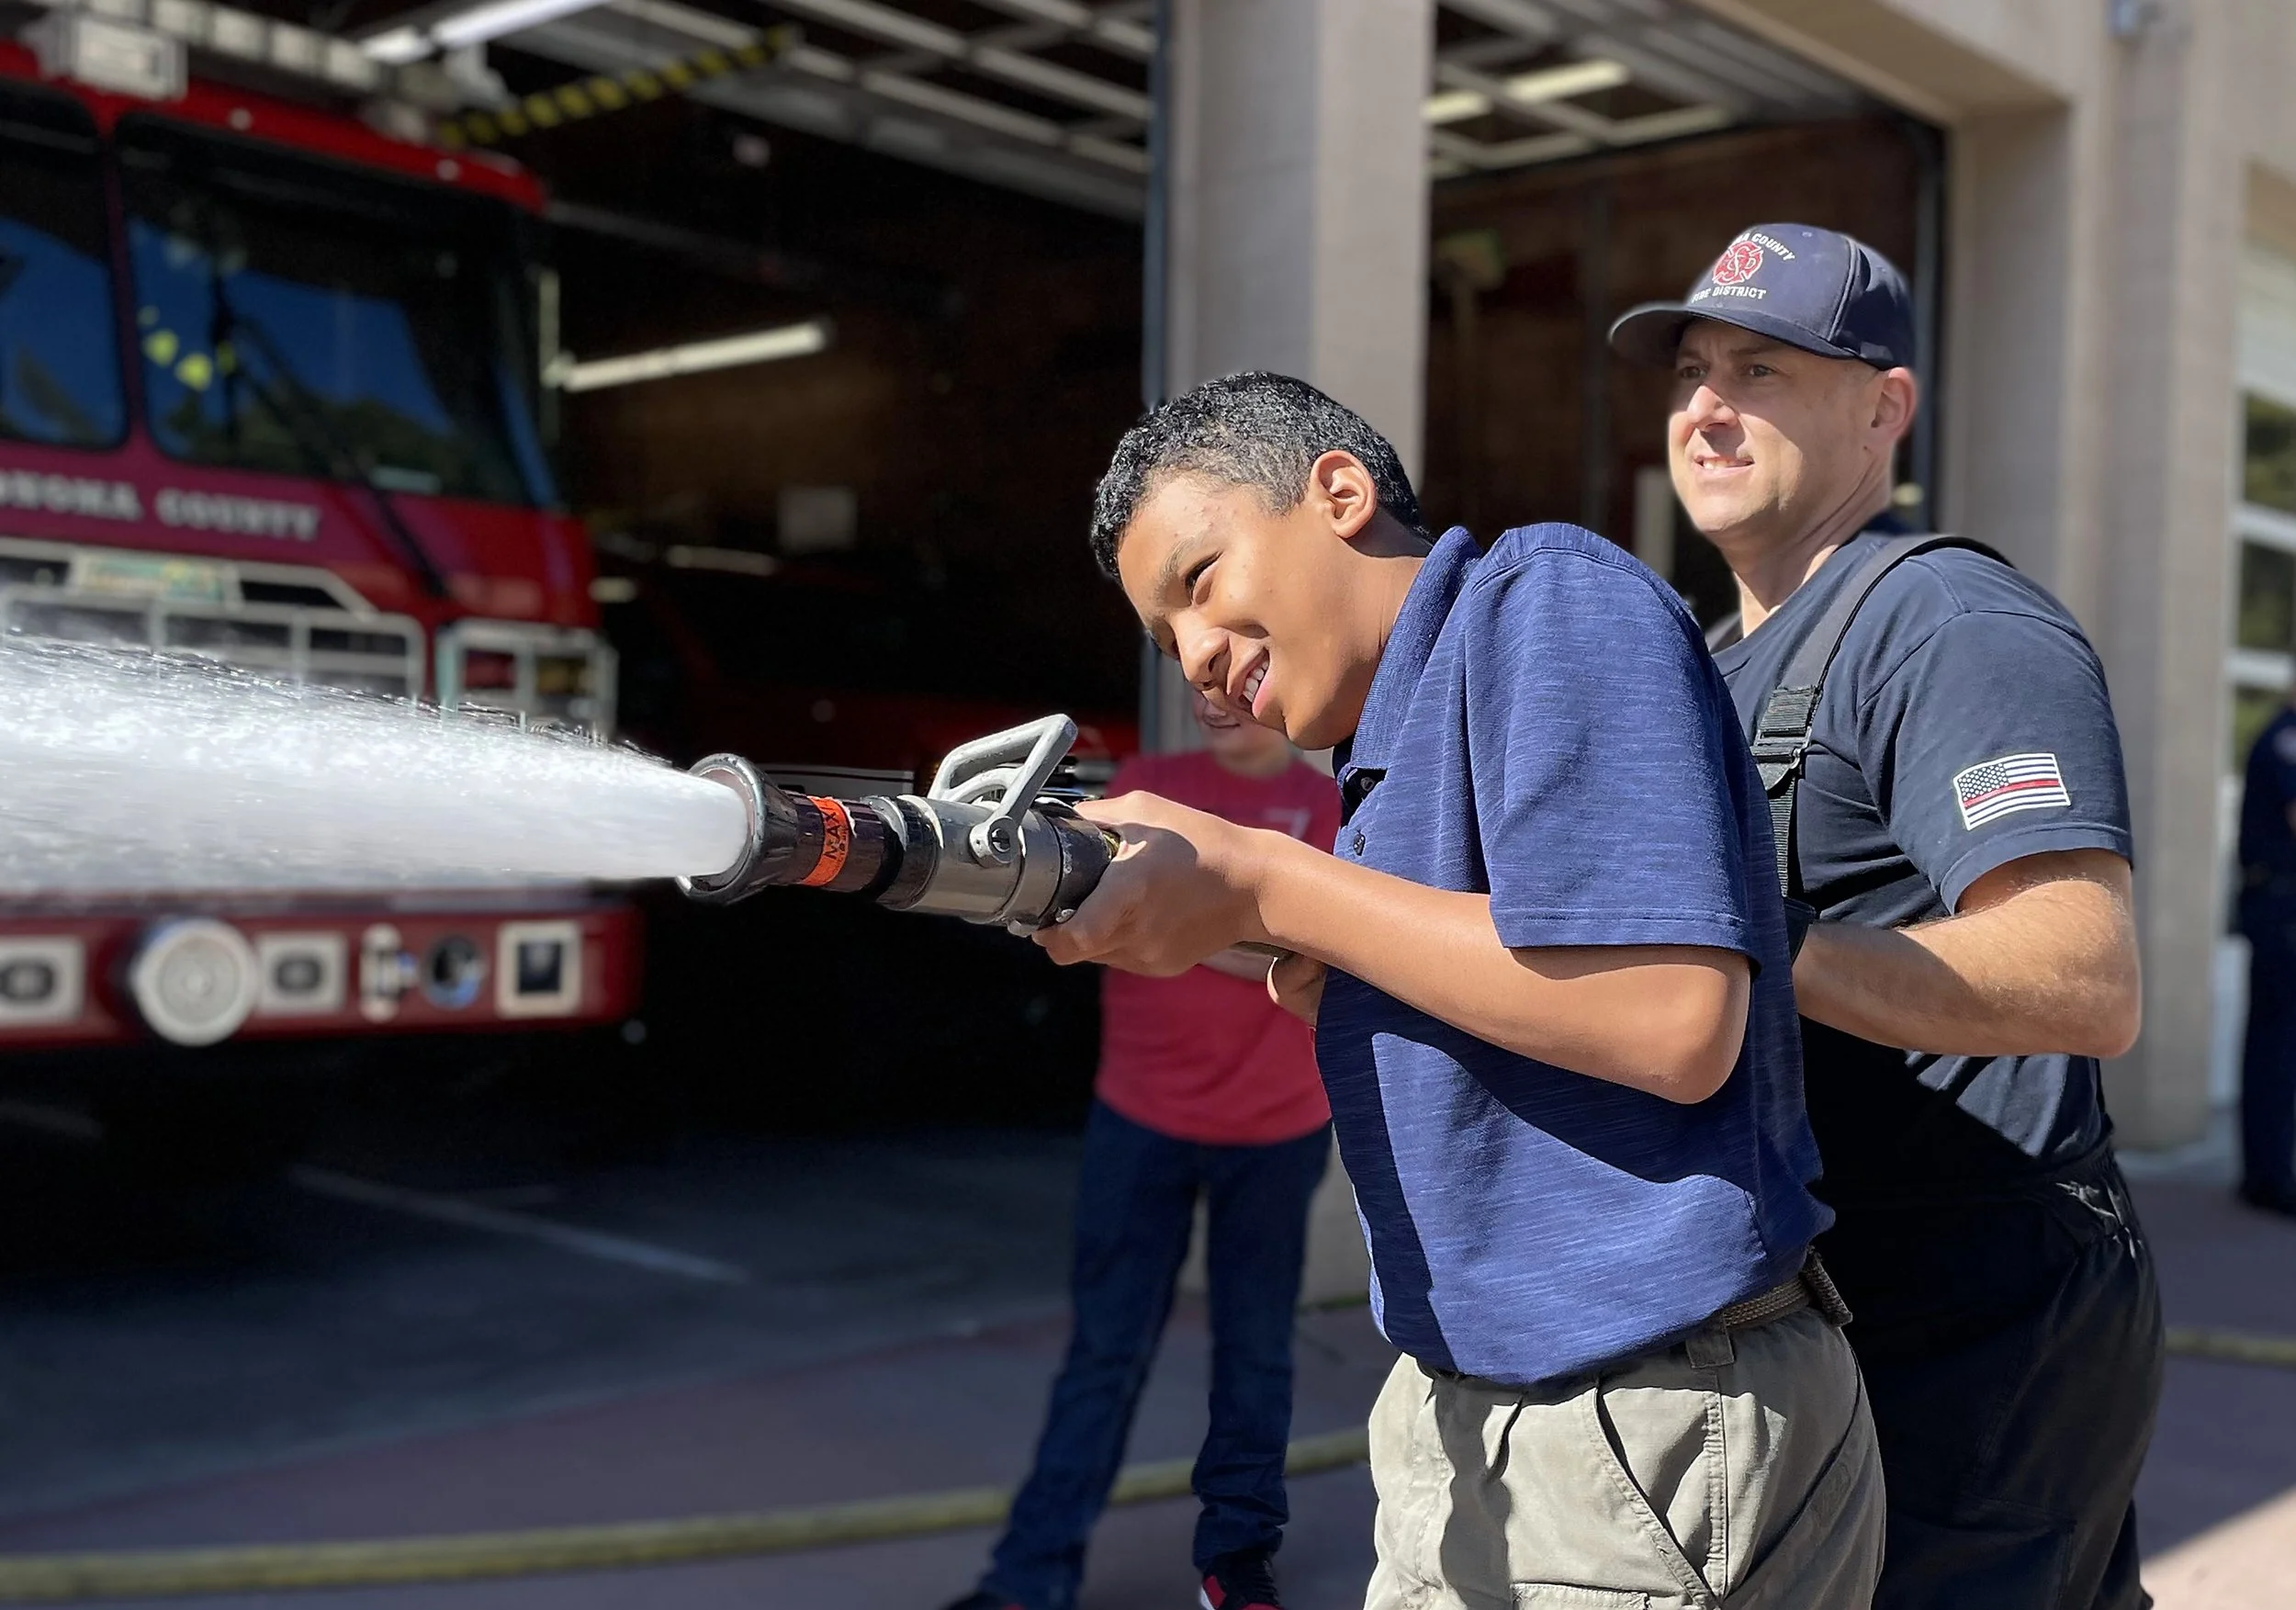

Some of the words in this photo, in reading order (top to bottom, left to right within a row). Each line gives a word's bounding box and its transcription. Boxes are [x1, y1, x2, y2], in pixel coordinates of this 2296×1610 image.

[1751, 233, 1795, 261] COUNTY
[1691, 287, 1712, 304] FIRE
[1712, 286, 1766, 299] DISTRICT
[155, 489, 320, 540] COUNTY
